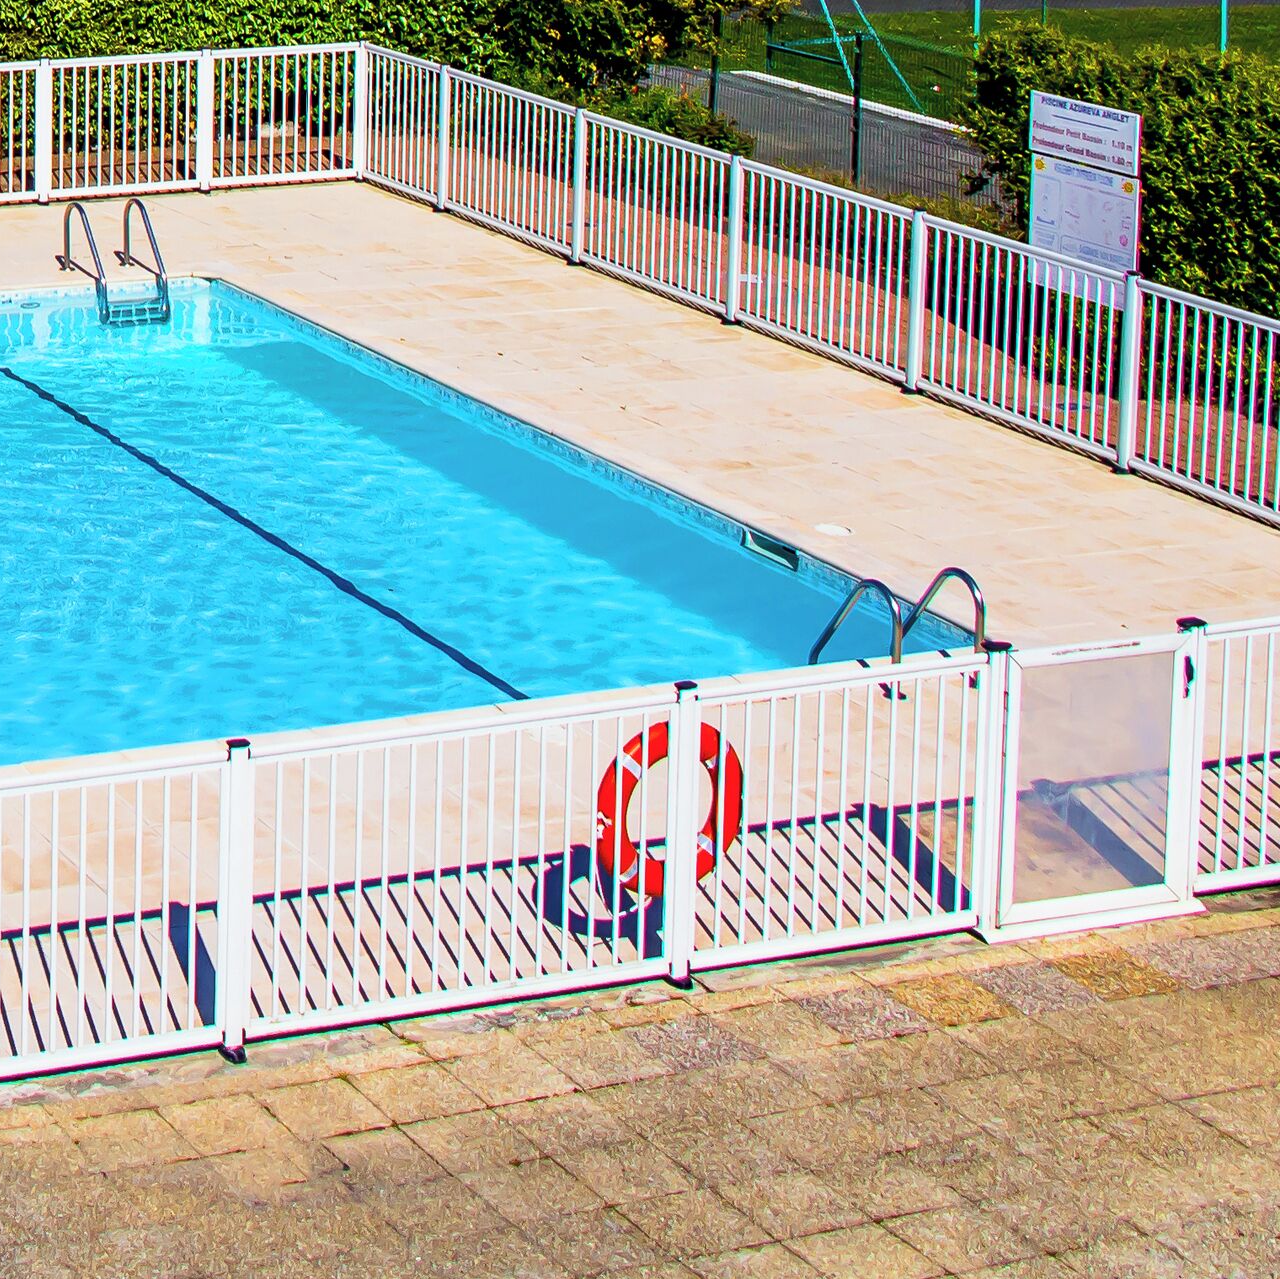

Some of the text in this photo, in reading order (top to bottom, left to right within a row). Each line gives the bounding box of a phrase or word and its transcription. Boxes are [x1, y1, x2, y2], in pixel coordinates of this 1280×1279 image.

[1041, 96, 1130, 123] PISCINE AZUREVA ANGLET
